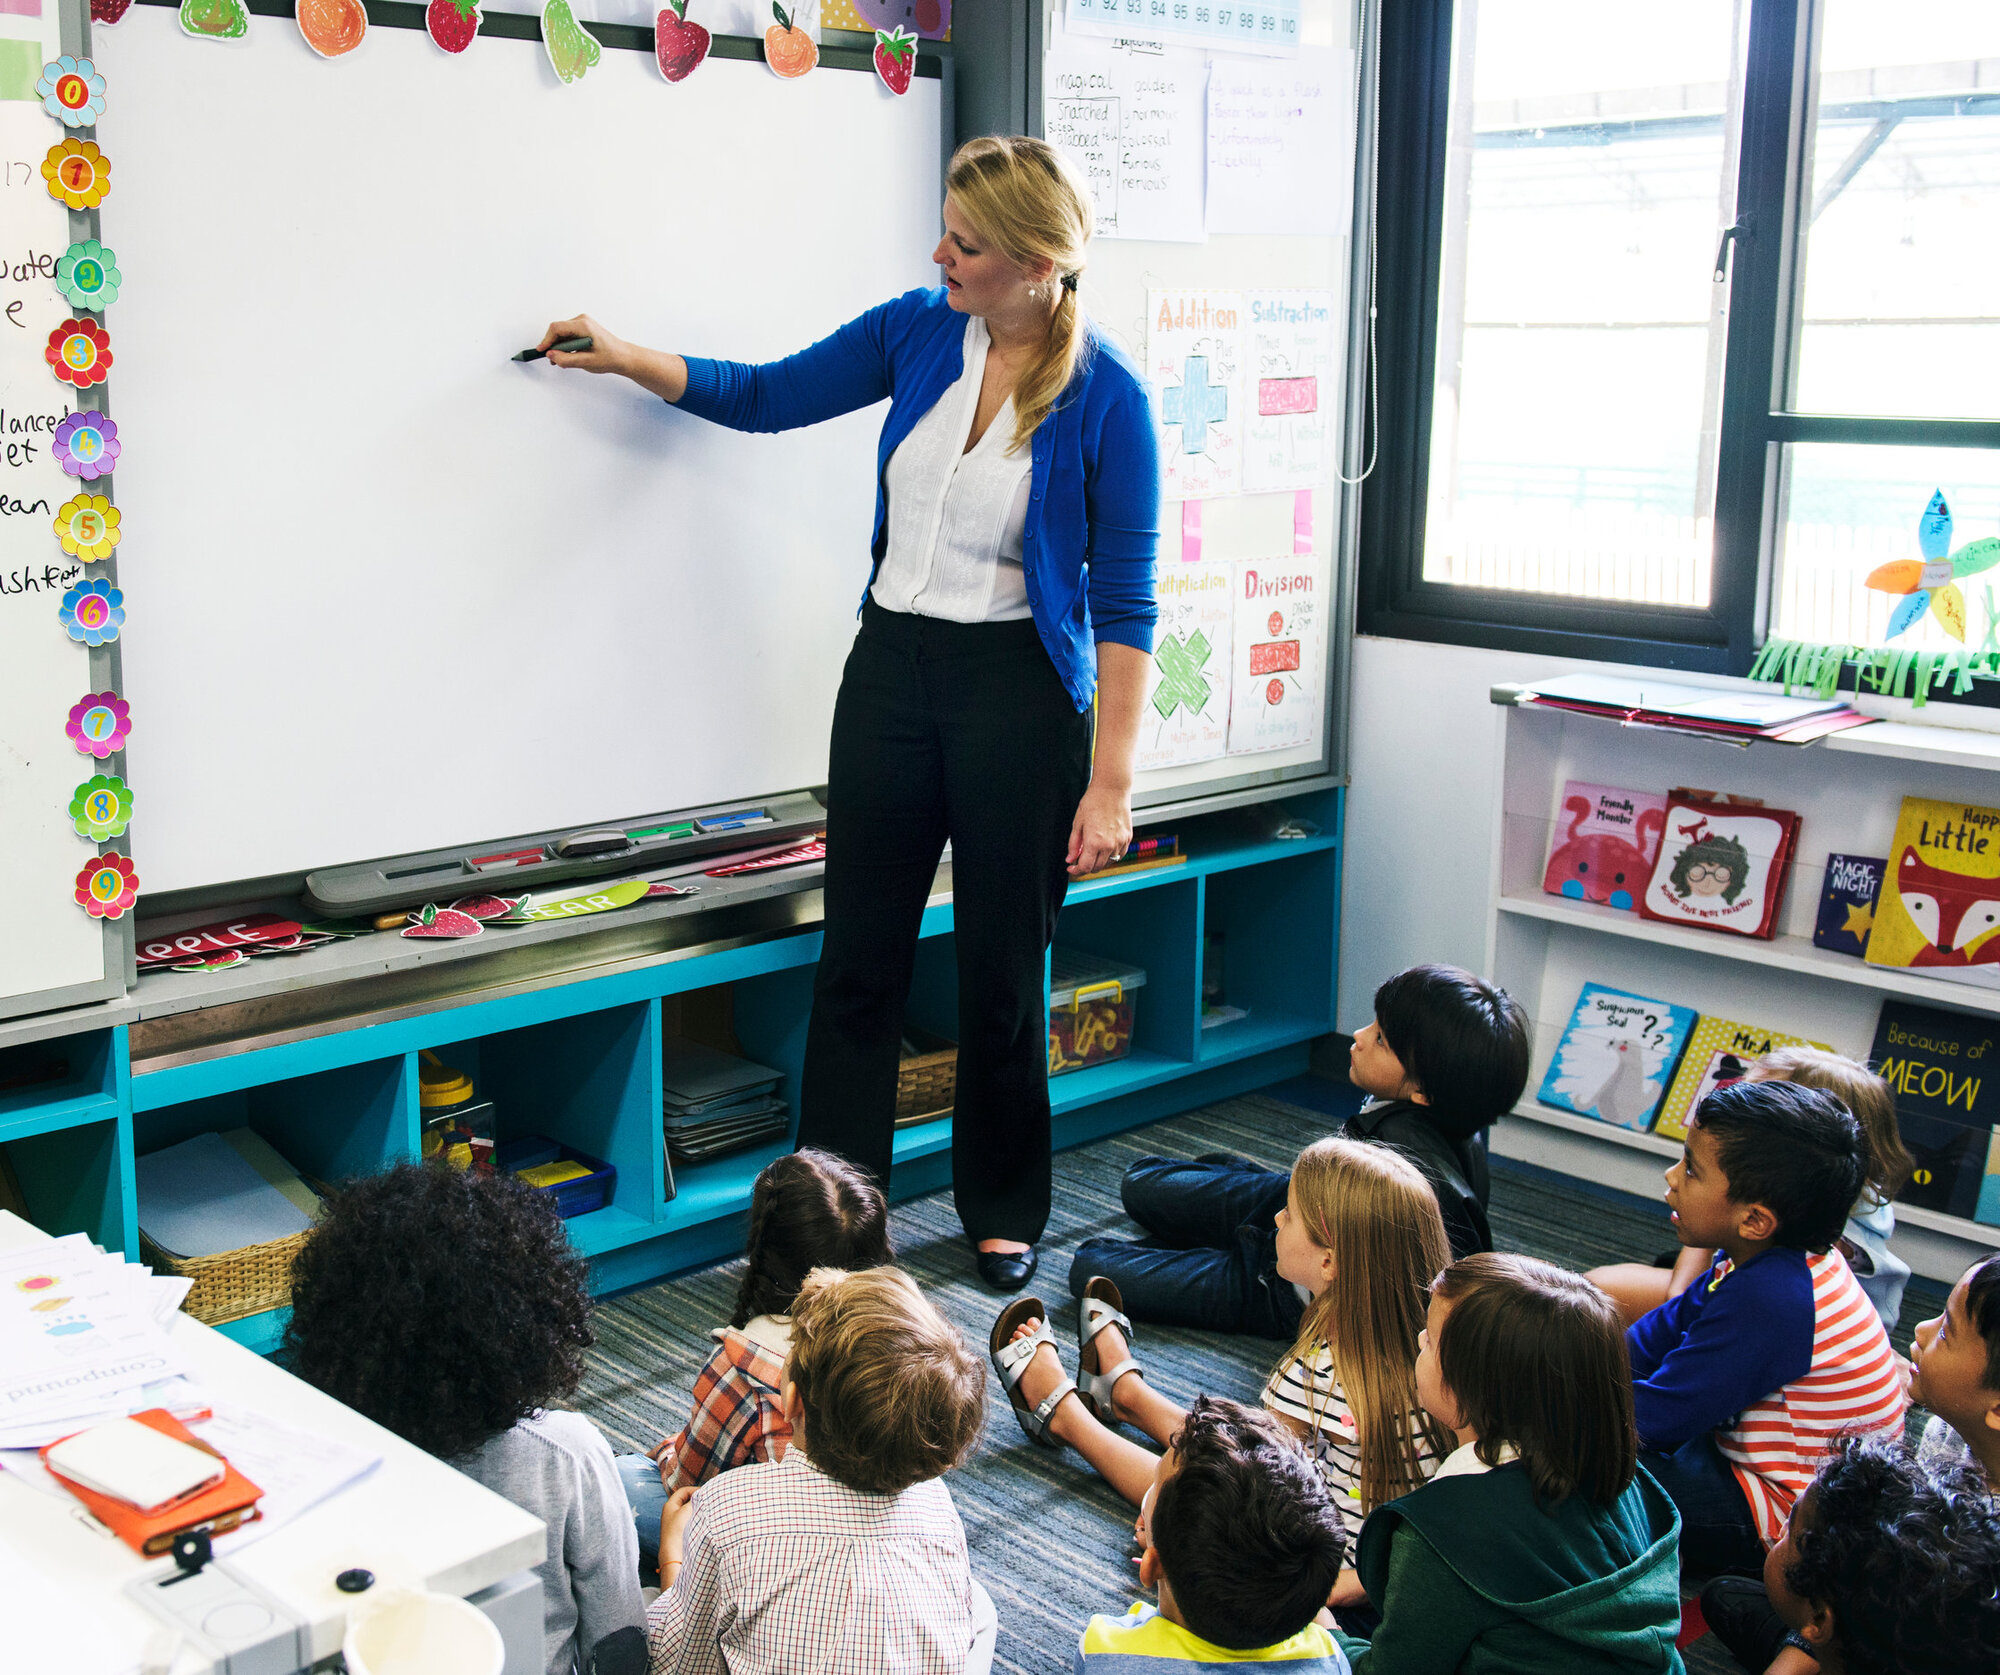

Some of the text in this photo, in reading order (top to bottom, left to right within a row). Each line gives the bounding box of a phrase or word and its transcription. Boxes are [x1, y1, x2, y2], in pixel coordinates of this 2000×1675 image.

[1103, 0, 1117, 11] 92
[1127, 0, 1142, 14] 93
[1151, 2, 1165, 17] 94
[1174, 5, 1188, 20] 95
[1196, 7, 1210, 22] 96
[1218, 10, 1232, 25] 97
[1239, 13, 1254, 28] 98
[1261, 16, 1275, 31] 99
[64, 80, 82, 104] 0
[1056, 68, 1114, 97] magical
[1136, 76, 1176, 100] golden
[1058, 102, 1109, 121] Snatched
[1121, 128, 1171, 149] colossal
[1085, 151, 1104, 162] ran
[1121, 151, 1162, 171] furious
[69, 162, 84, 187] 1
[1088, 165, 1112, 189] sang
[79, 262, 99, 289] 2
[1157, 297, 1237, 332] Addition
[1252, 299, 1329, 325] Subtraction
[70, 338, 87, 366] 3
[0, 437, 38, 468] et
[78, 431, 96, 456] 4
[80, 515, 96, 540] 5
[1156, 571, 1226, 597] ultiplication
[1245, 570, 1313, 600] Division
[83, 598, 101, 625] 6
[91, 713, 108, 738] 7
[94, 793, 110, 821] 8
[1597, 809, 1632, 825] Monster
[1600, 795, 1635, 815] Friendly
[1963, 808, 2000, 831] Happ
[1919, 820, 1989, 855] Little
[1831, 860, 1875, 880] MAGIC
[99, 872, 115, 899] 9
[1833, 874, 1878, 894] NIGHT
[1721, 897, 1754, 916] FRIEND
[1597, 999, 1645, 1015] Suspicious
[1607, 1015, 1628, 1028] Seal
[1888, 1022, 1993, 1059] Because of
[1878, 1056, 1981, 1111] MEOW
[6, 1357, 167, 1404] Compound
